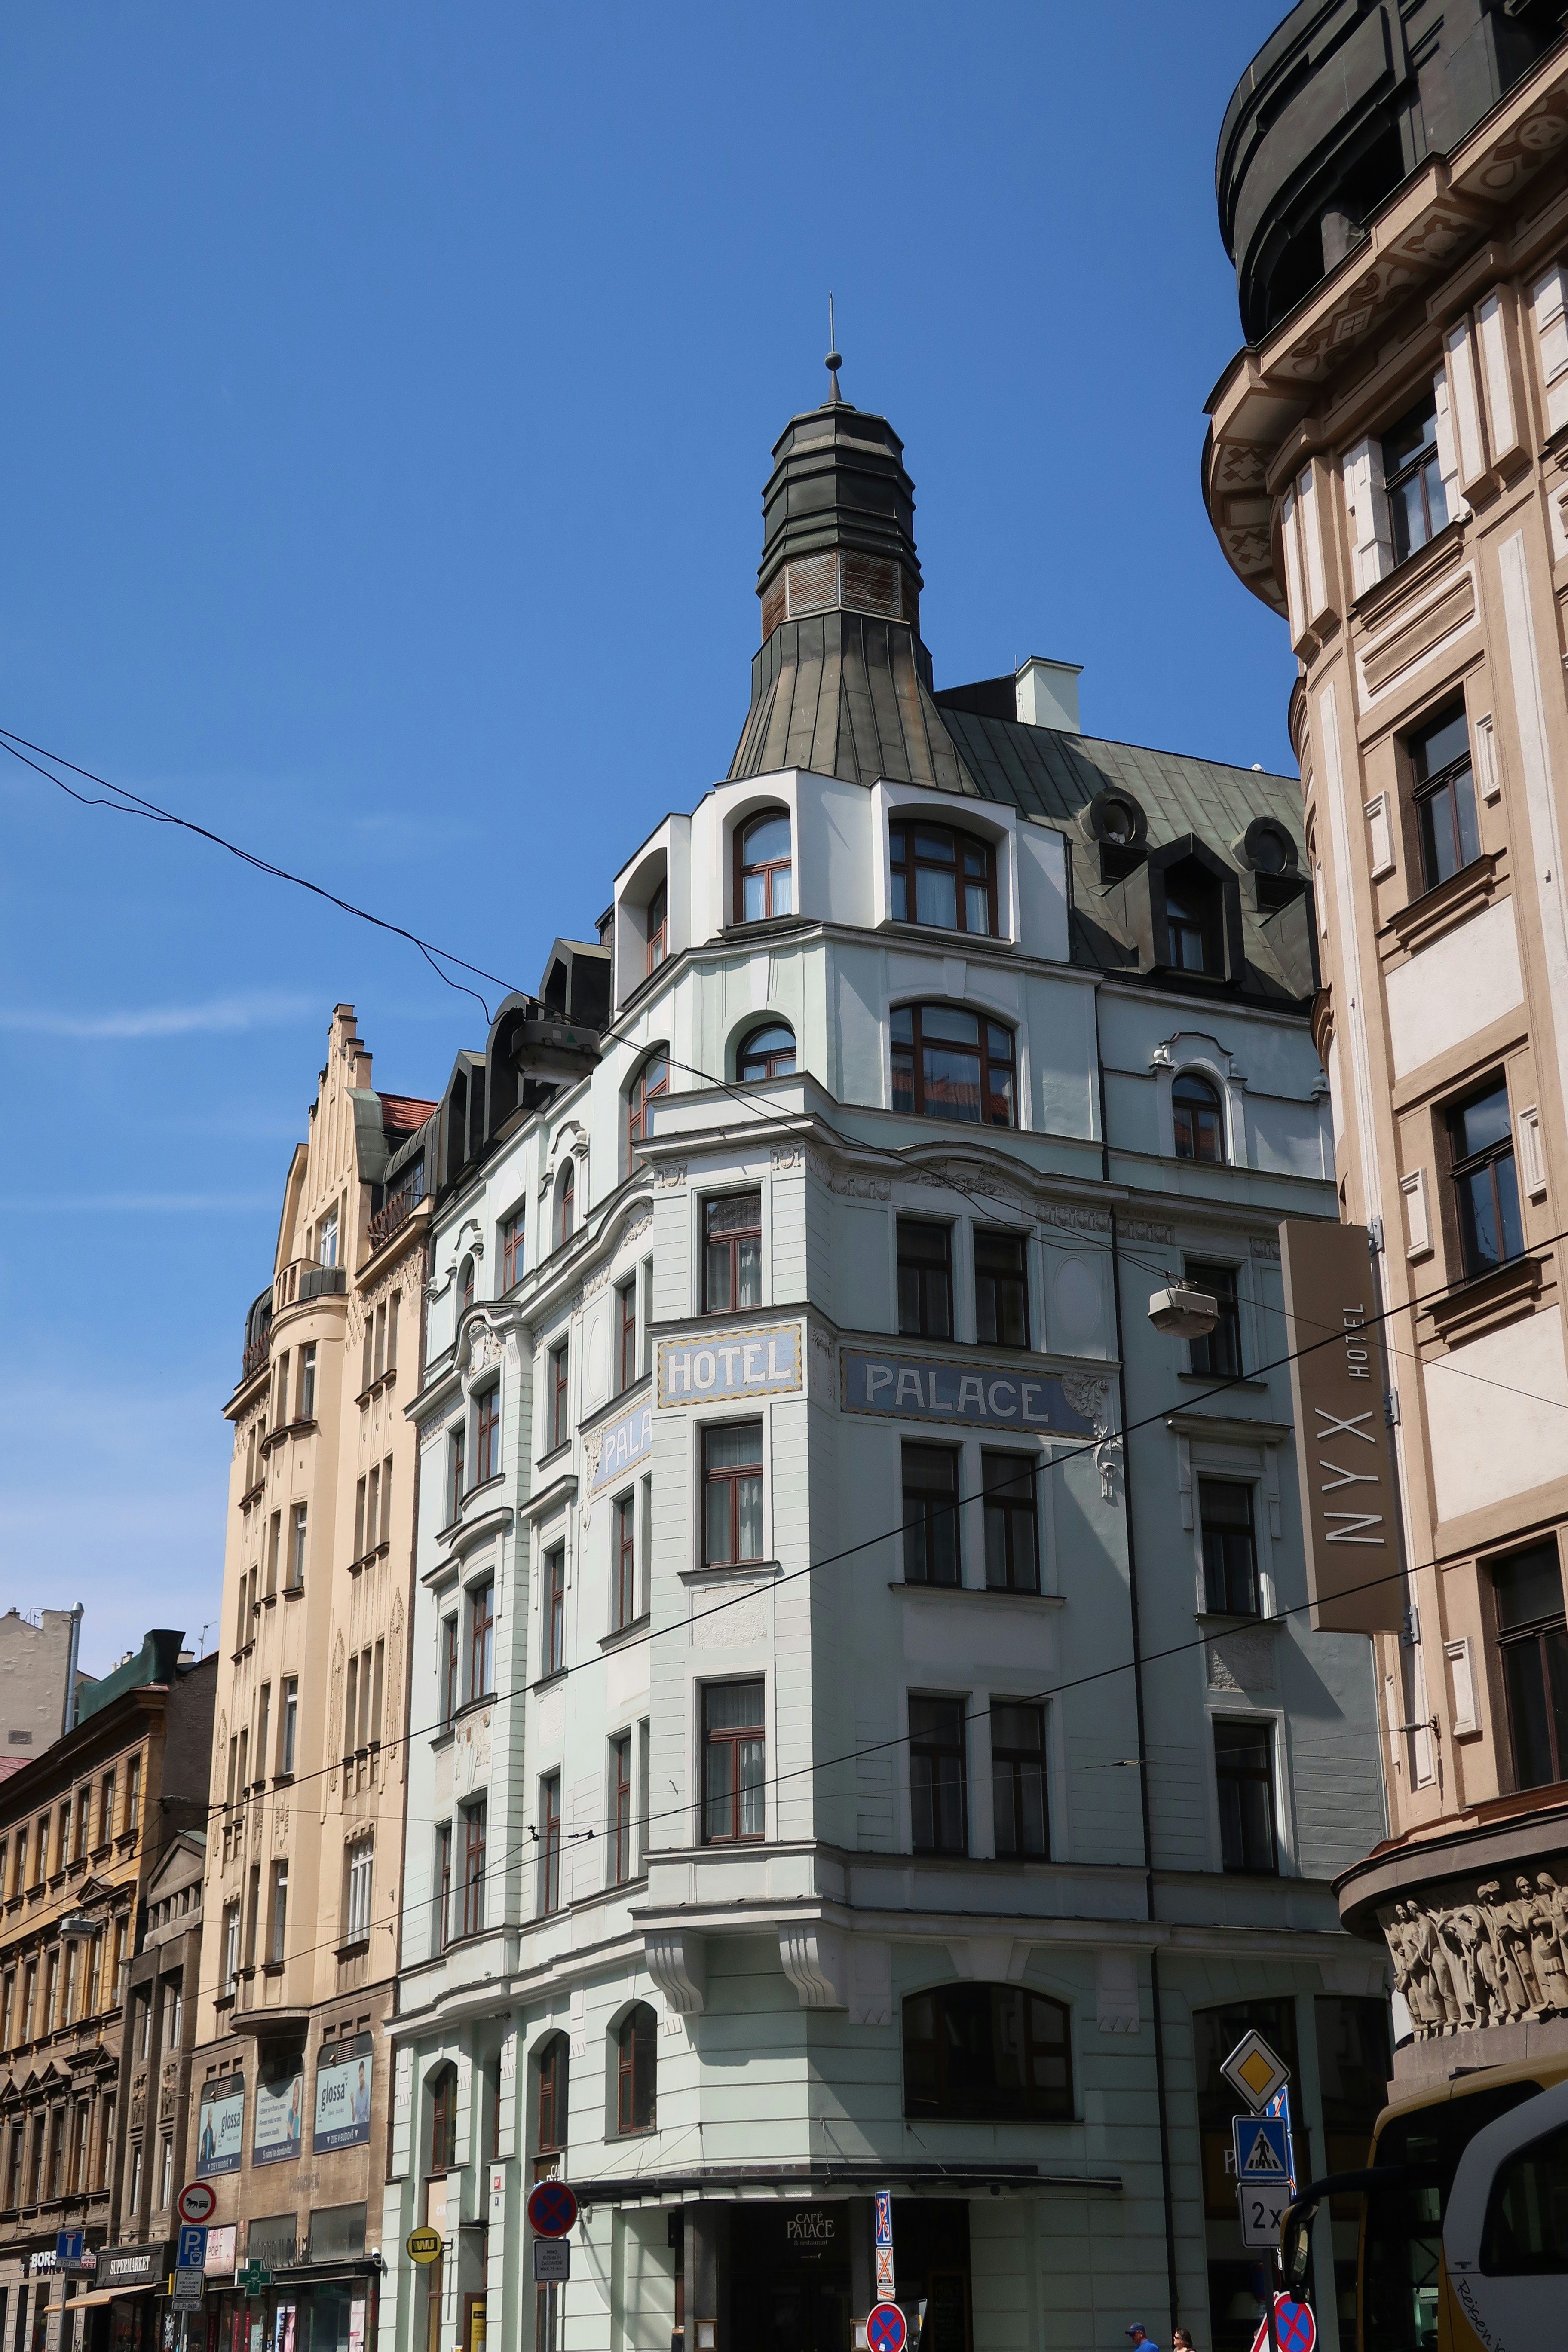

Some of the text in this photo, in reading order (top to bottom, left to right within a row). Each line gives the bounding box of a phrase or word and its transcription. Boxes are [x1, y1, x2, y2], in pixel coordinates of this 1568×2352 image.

[1343, 1303, 1370, 1378] HOTEL
[667, 1341, 791, 1394] HOTEL
[864, 1364, 1049, 1423] PALACE
[1315, 1407, 1385, 1544] NYX
[321, 2080, 345, 2112] glossa
[221, 2109, 240, 2138] glossa
[787, 2220, 835, 2238] PALACE
[796, 2210, 824, 2223] CAFÉ
[184, 2231, 201, 2254] P
[413, 2239, 435, 2251] WU
[110, 2256, 150, 2275] SUPERMARKET
[1457, 2278, 1492, 2346] Reisen
